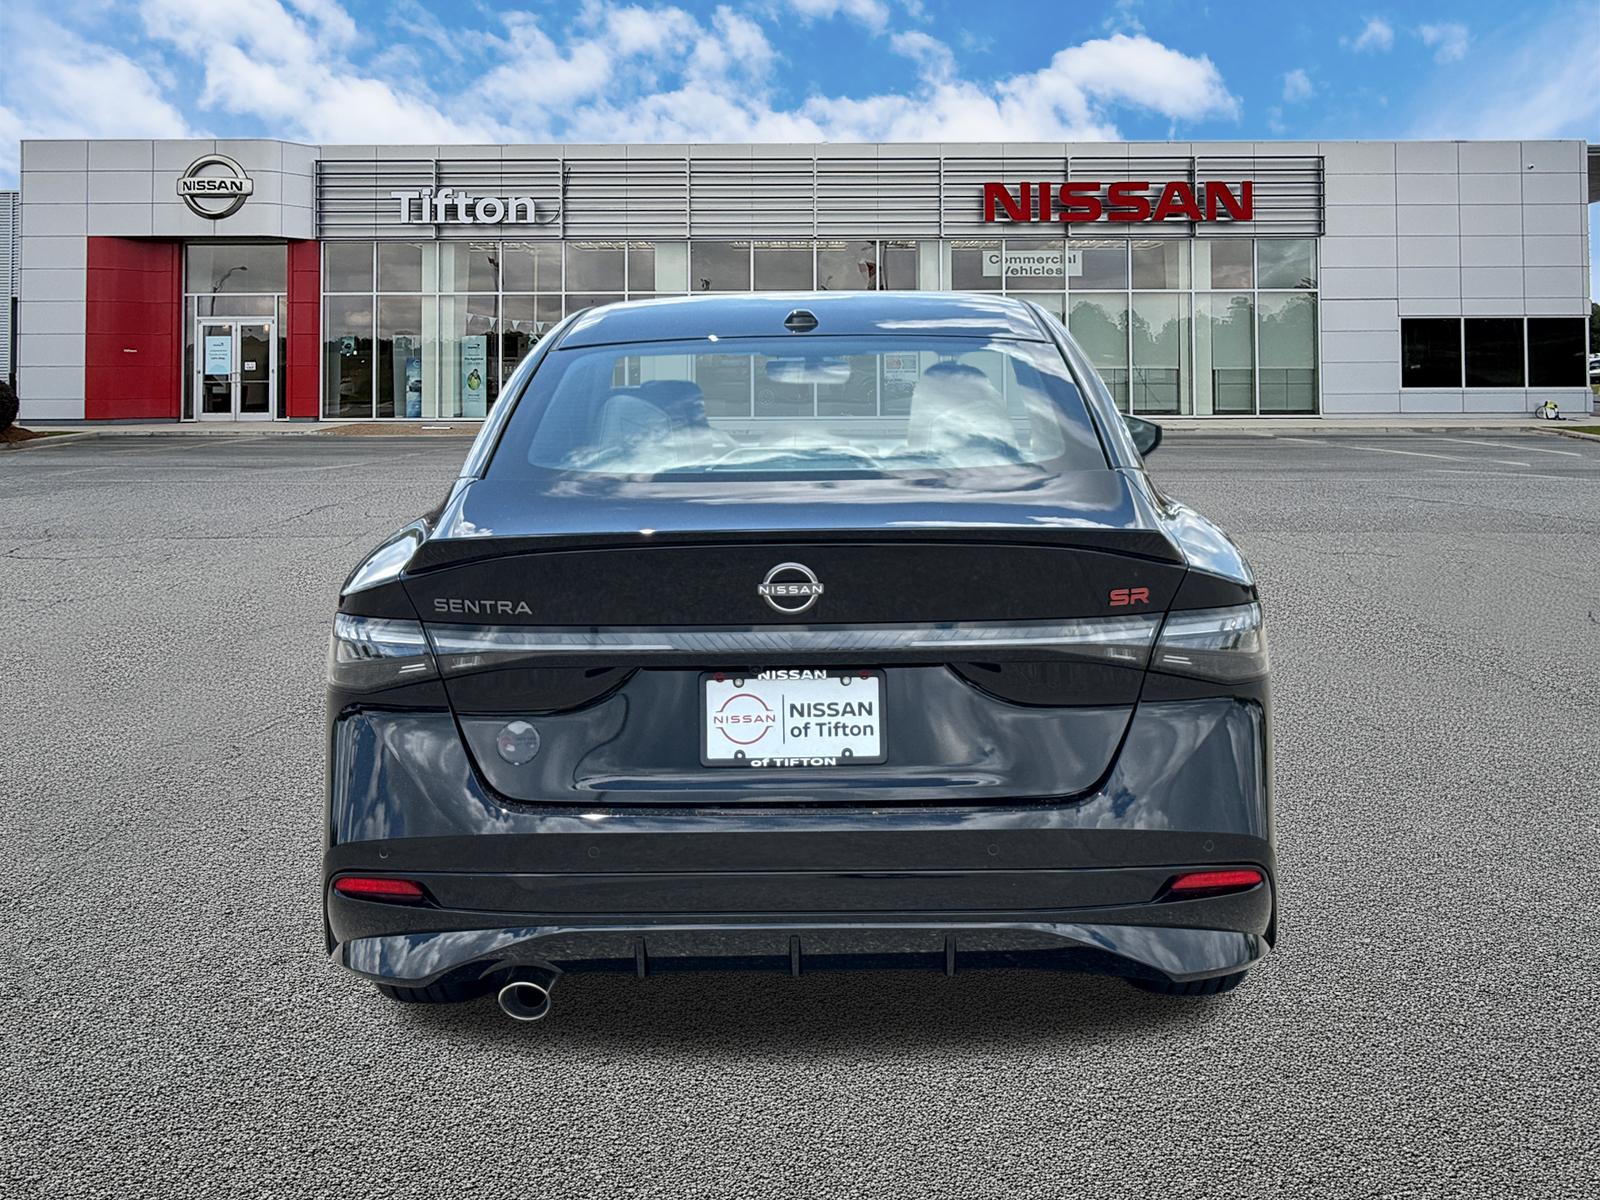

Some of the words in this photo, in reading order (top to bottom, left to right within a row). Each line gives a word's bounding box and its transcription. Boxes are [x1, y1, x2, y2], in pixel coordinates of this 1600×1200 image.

[183, 180, 243, 191] NISSAN
[390, 187, 537, 224] Tifton
[983, 180, 1253, 223] NISSAN
[759, 584, 822, 595] NISSAN
[1109, 586, 1150, 606] SR
[433, 598, 533, 615] SENTRA
[757, 669, 827, 681] NISSAN
[789, 701, 873, 718] NISSAN
[713, 713, 776, 724] NISSAN
[790, 722, 811, 738] of
[815, 721, 874, 737] Tifton
[750, 757, 771, 767] of
[773, 756, 837, 767] TIFTON
